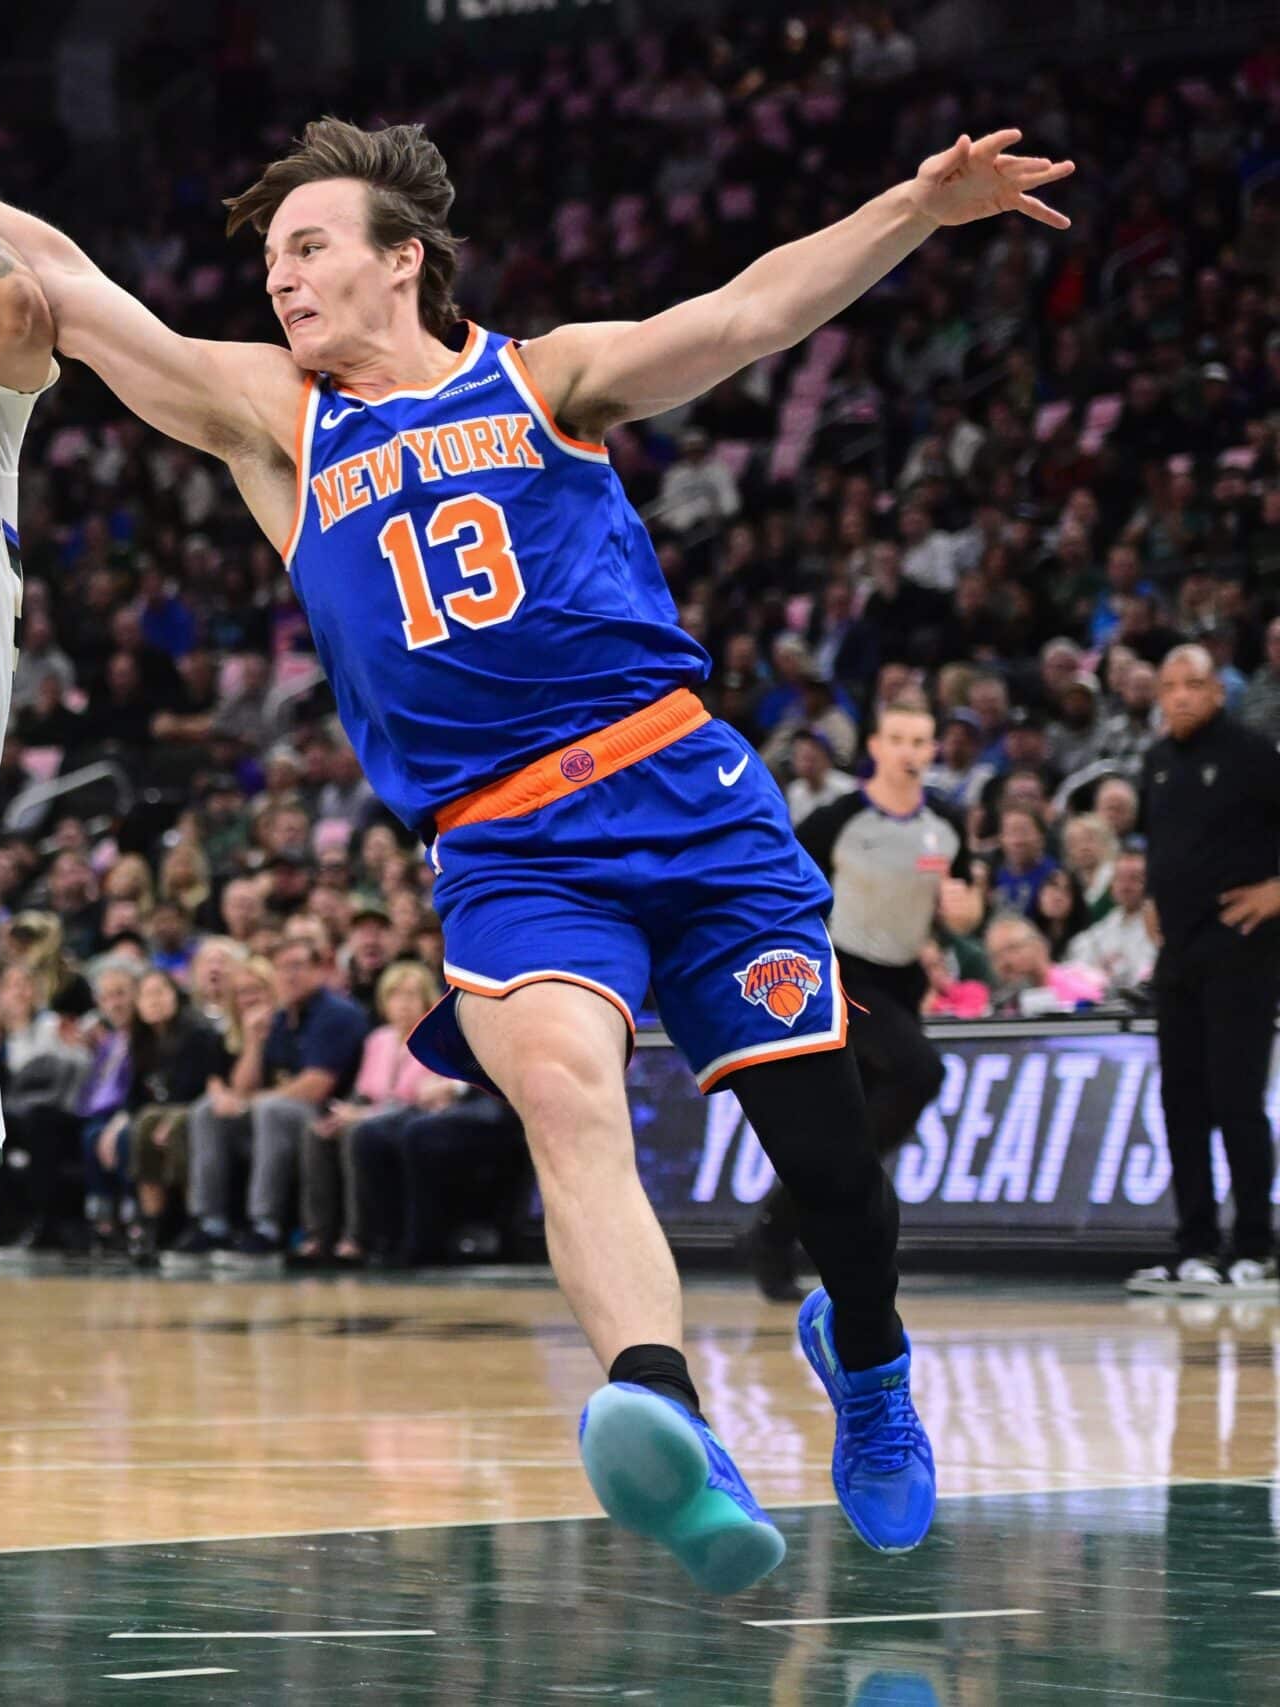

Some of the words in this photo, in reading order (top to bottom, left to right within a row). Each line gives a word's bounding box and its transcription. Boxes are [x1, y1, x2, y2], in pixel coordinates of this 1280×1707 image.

[310, 433, 404, 534] NEW
[398, 413, 545, 483] YORK
[377, 492, 526, 651] 13
[743, 955, 821, 998] KNICKS
[894, 1052, 1102, 1204] SEAT
